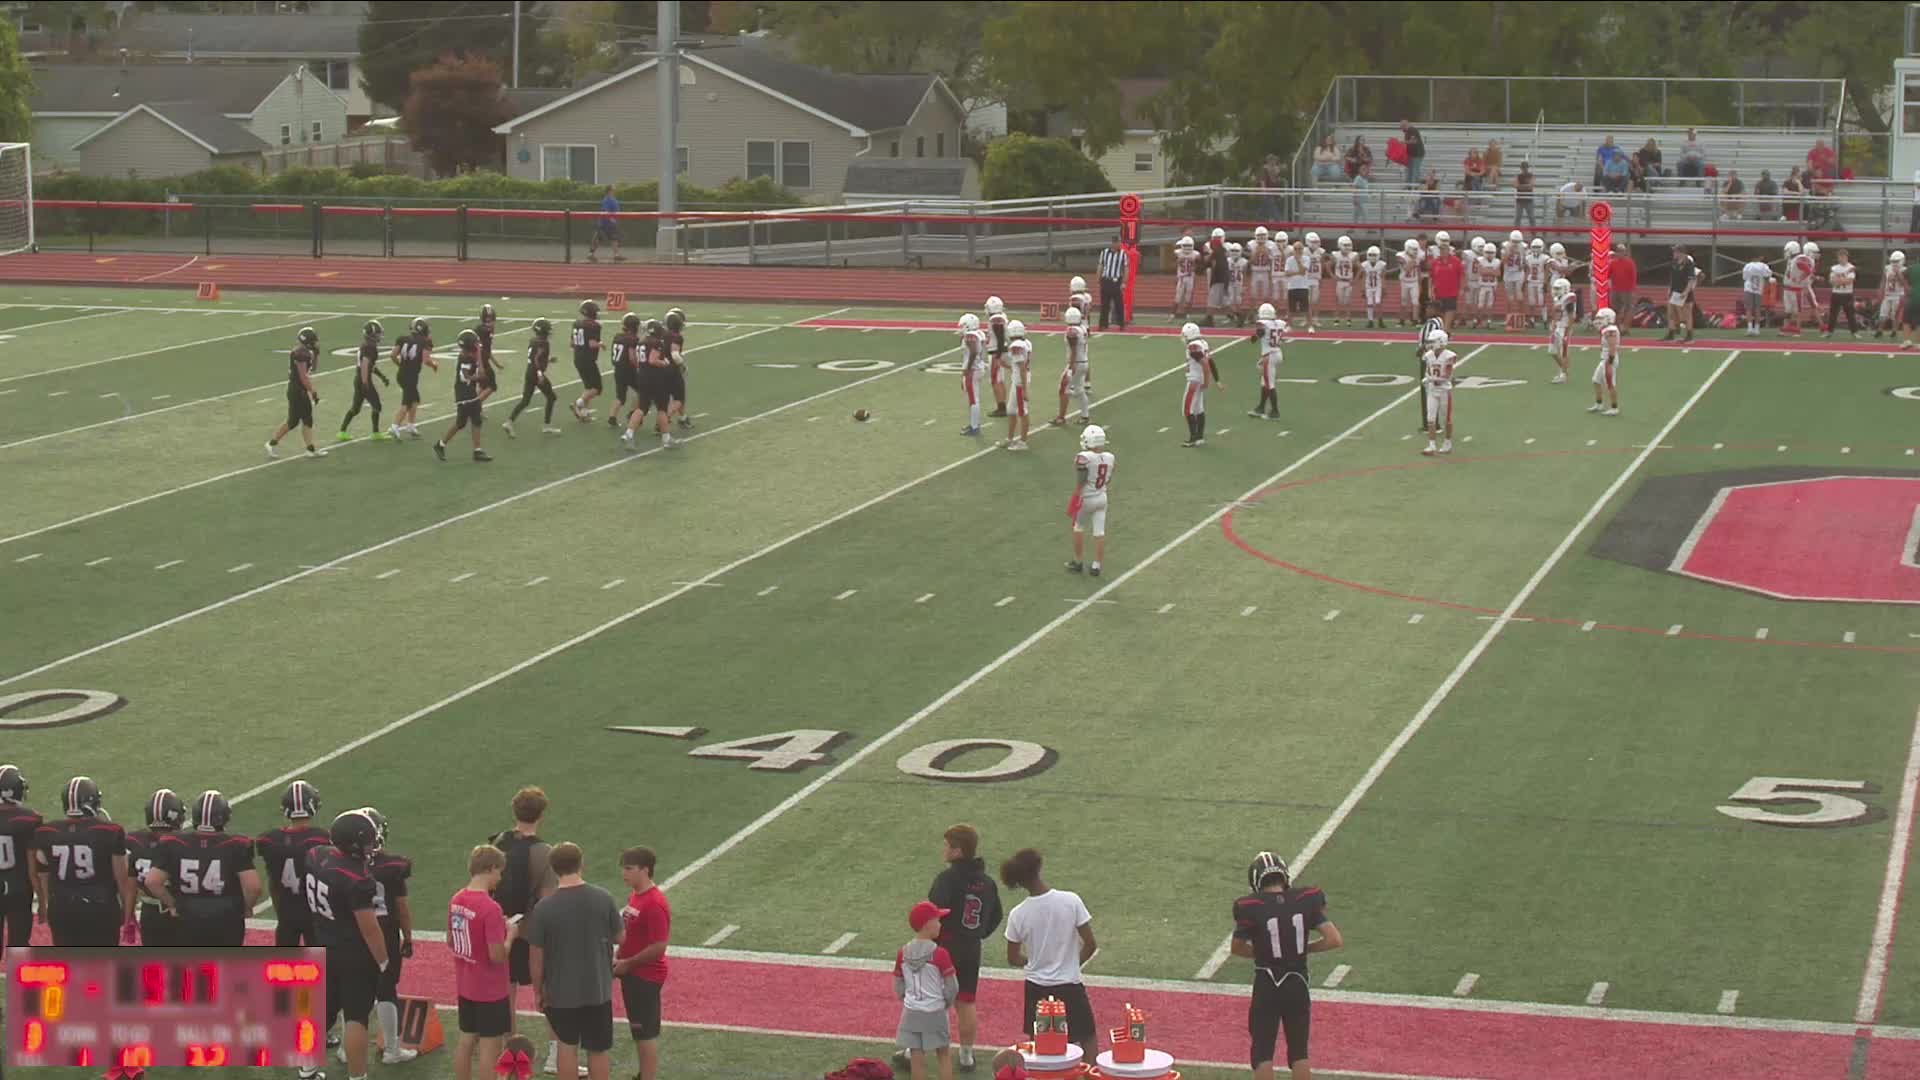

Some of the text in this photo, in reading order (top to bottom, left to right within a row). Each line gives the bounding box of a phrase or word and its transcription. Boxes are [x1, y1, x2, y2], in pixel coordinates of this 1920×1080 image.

[608, 293, 623, 307] 20
[1040, 303, 1058, 317] 30
[400, 343, 418, 361] 44
[1095, 463, 1109, 490] 8
[1716, 776, 1868, 823] 5
[52, 844, 96, 881] 79
[180, 858, 225, 895] 54
[305, 872, 336, 921] 65
[1266, 913, 1305, 959] 11
